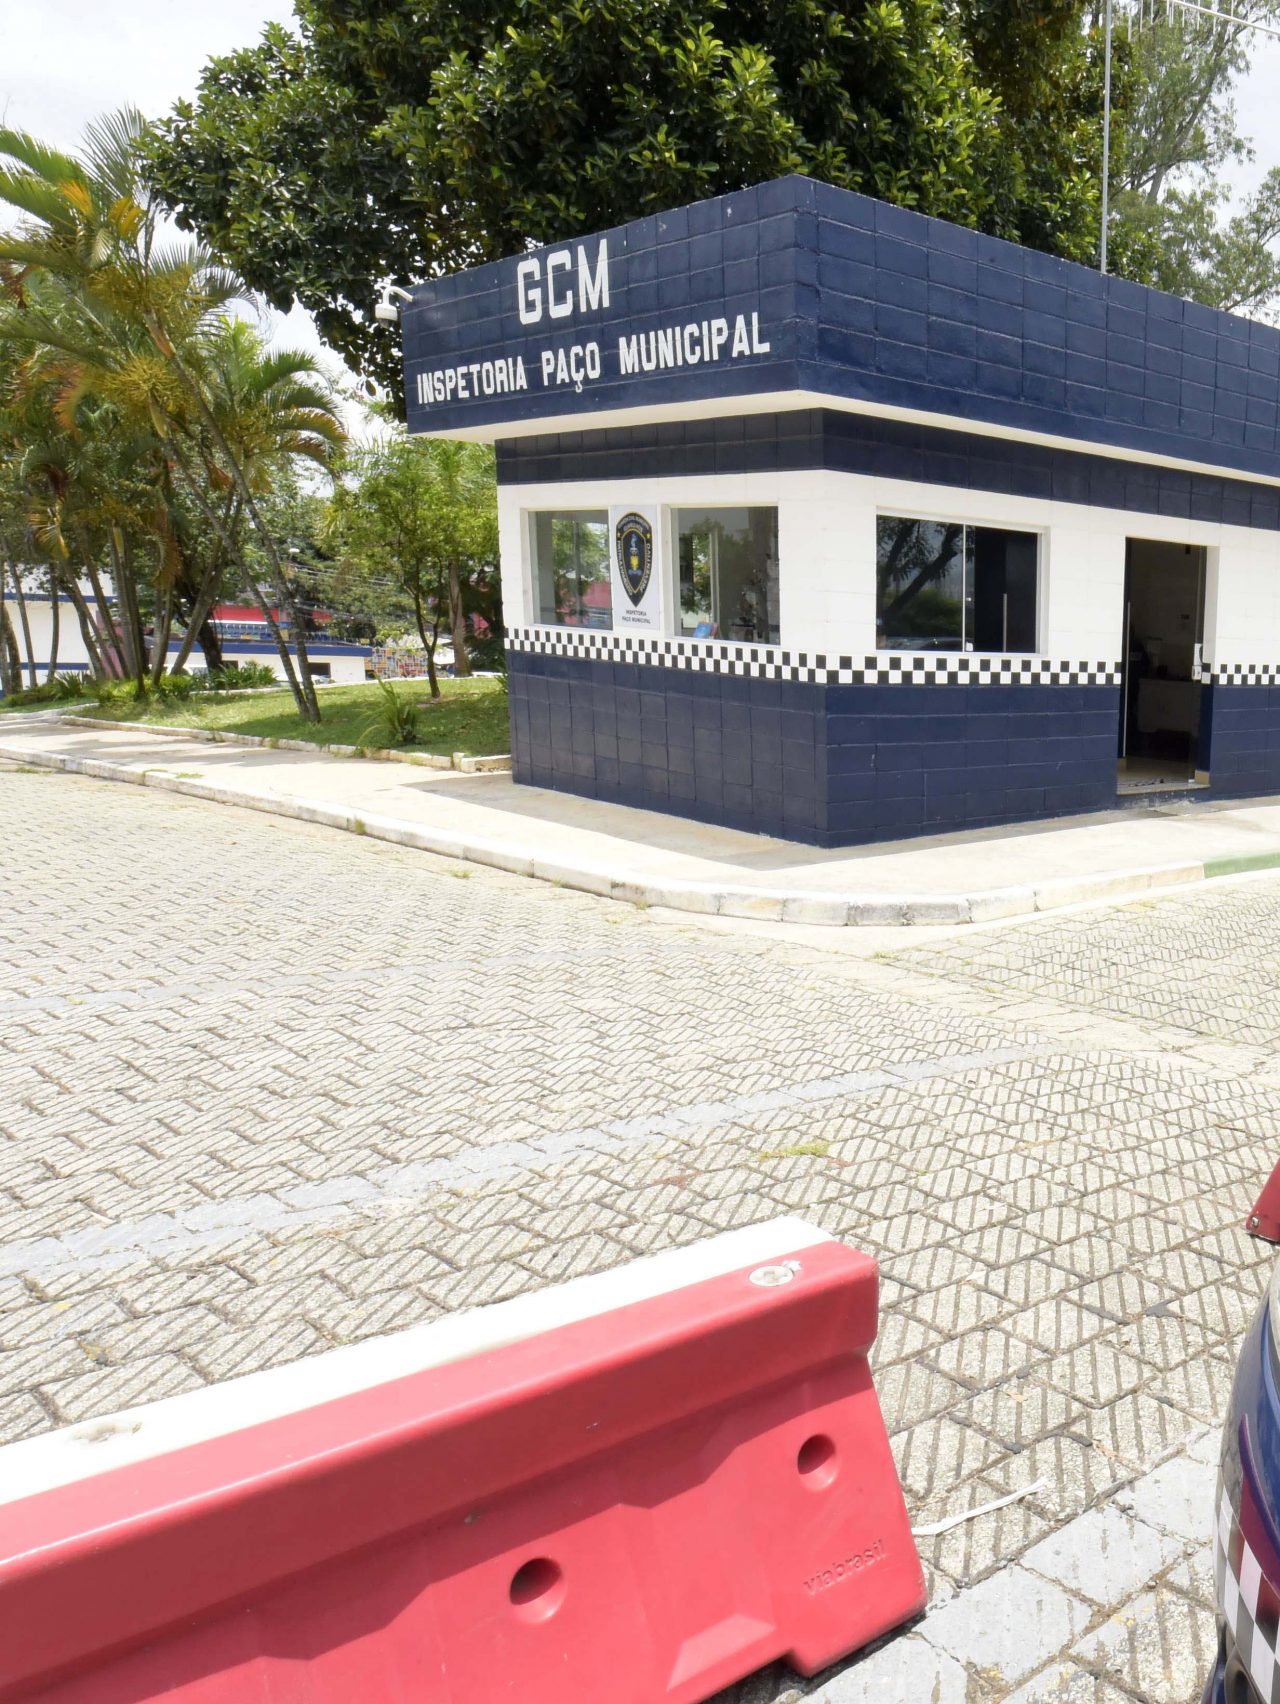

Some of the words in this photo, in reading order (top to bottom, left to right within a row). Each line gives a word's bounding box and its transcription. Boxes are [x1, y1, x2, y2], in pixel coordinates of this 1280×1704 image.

[517, 239, 610, 326] GCM
[417, 355, 528, 405] INSPETORIA
[541, 342, 601, 393] PAÇO
[619, 312, 771, 375] MUNICIPAL
